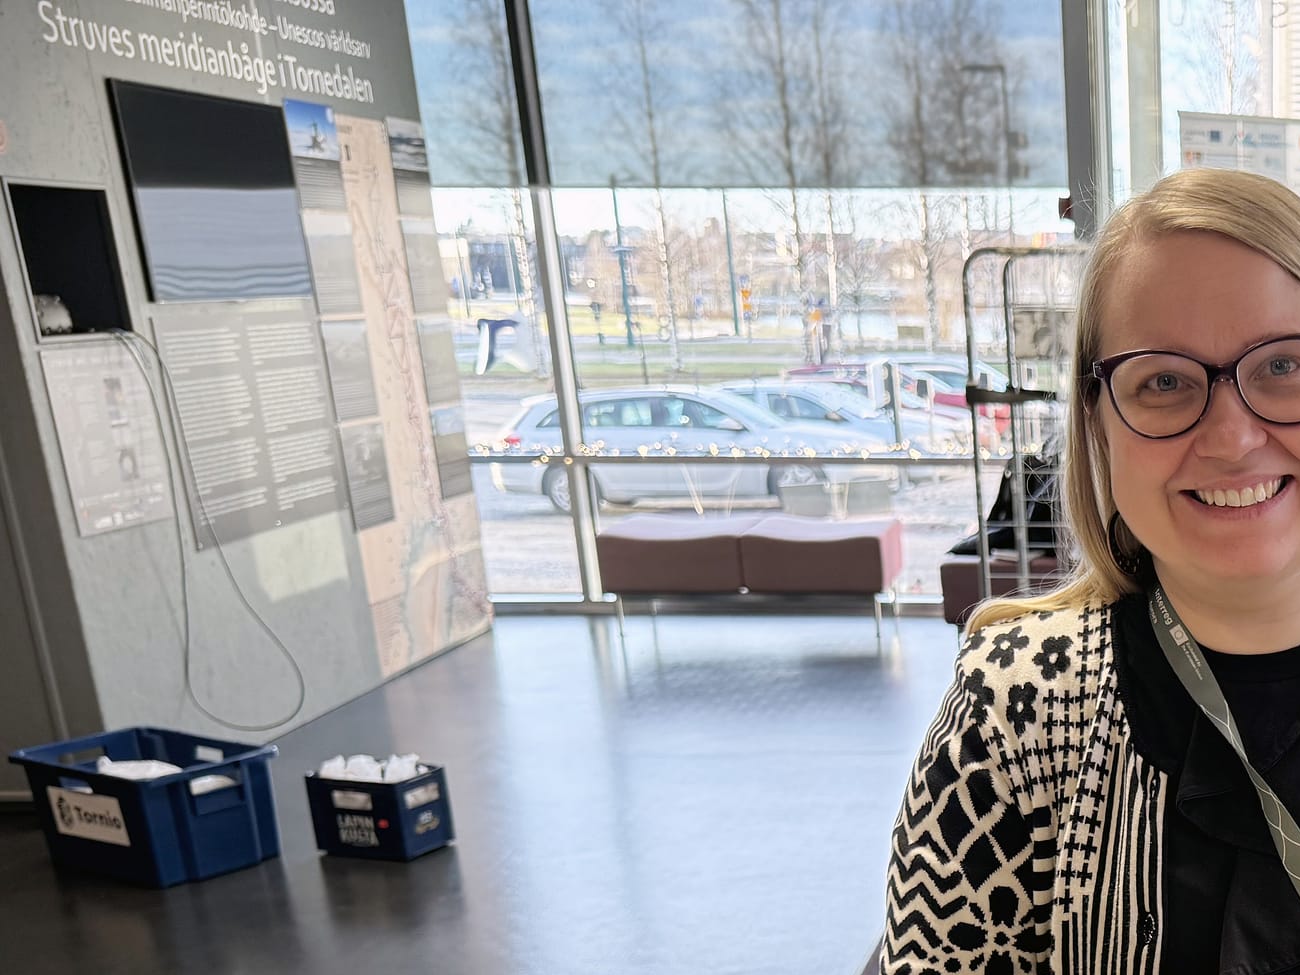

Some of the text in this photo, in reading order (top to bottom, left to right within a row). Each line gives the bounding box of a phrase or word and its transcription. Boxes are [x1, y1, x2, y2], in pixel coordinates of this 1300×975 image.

[277, 16, 325, 48] Unescos
[38, 1, 374, 104] Struves meridianbåge i Tornedalen
[74, 805, 122, 831] Tornio
